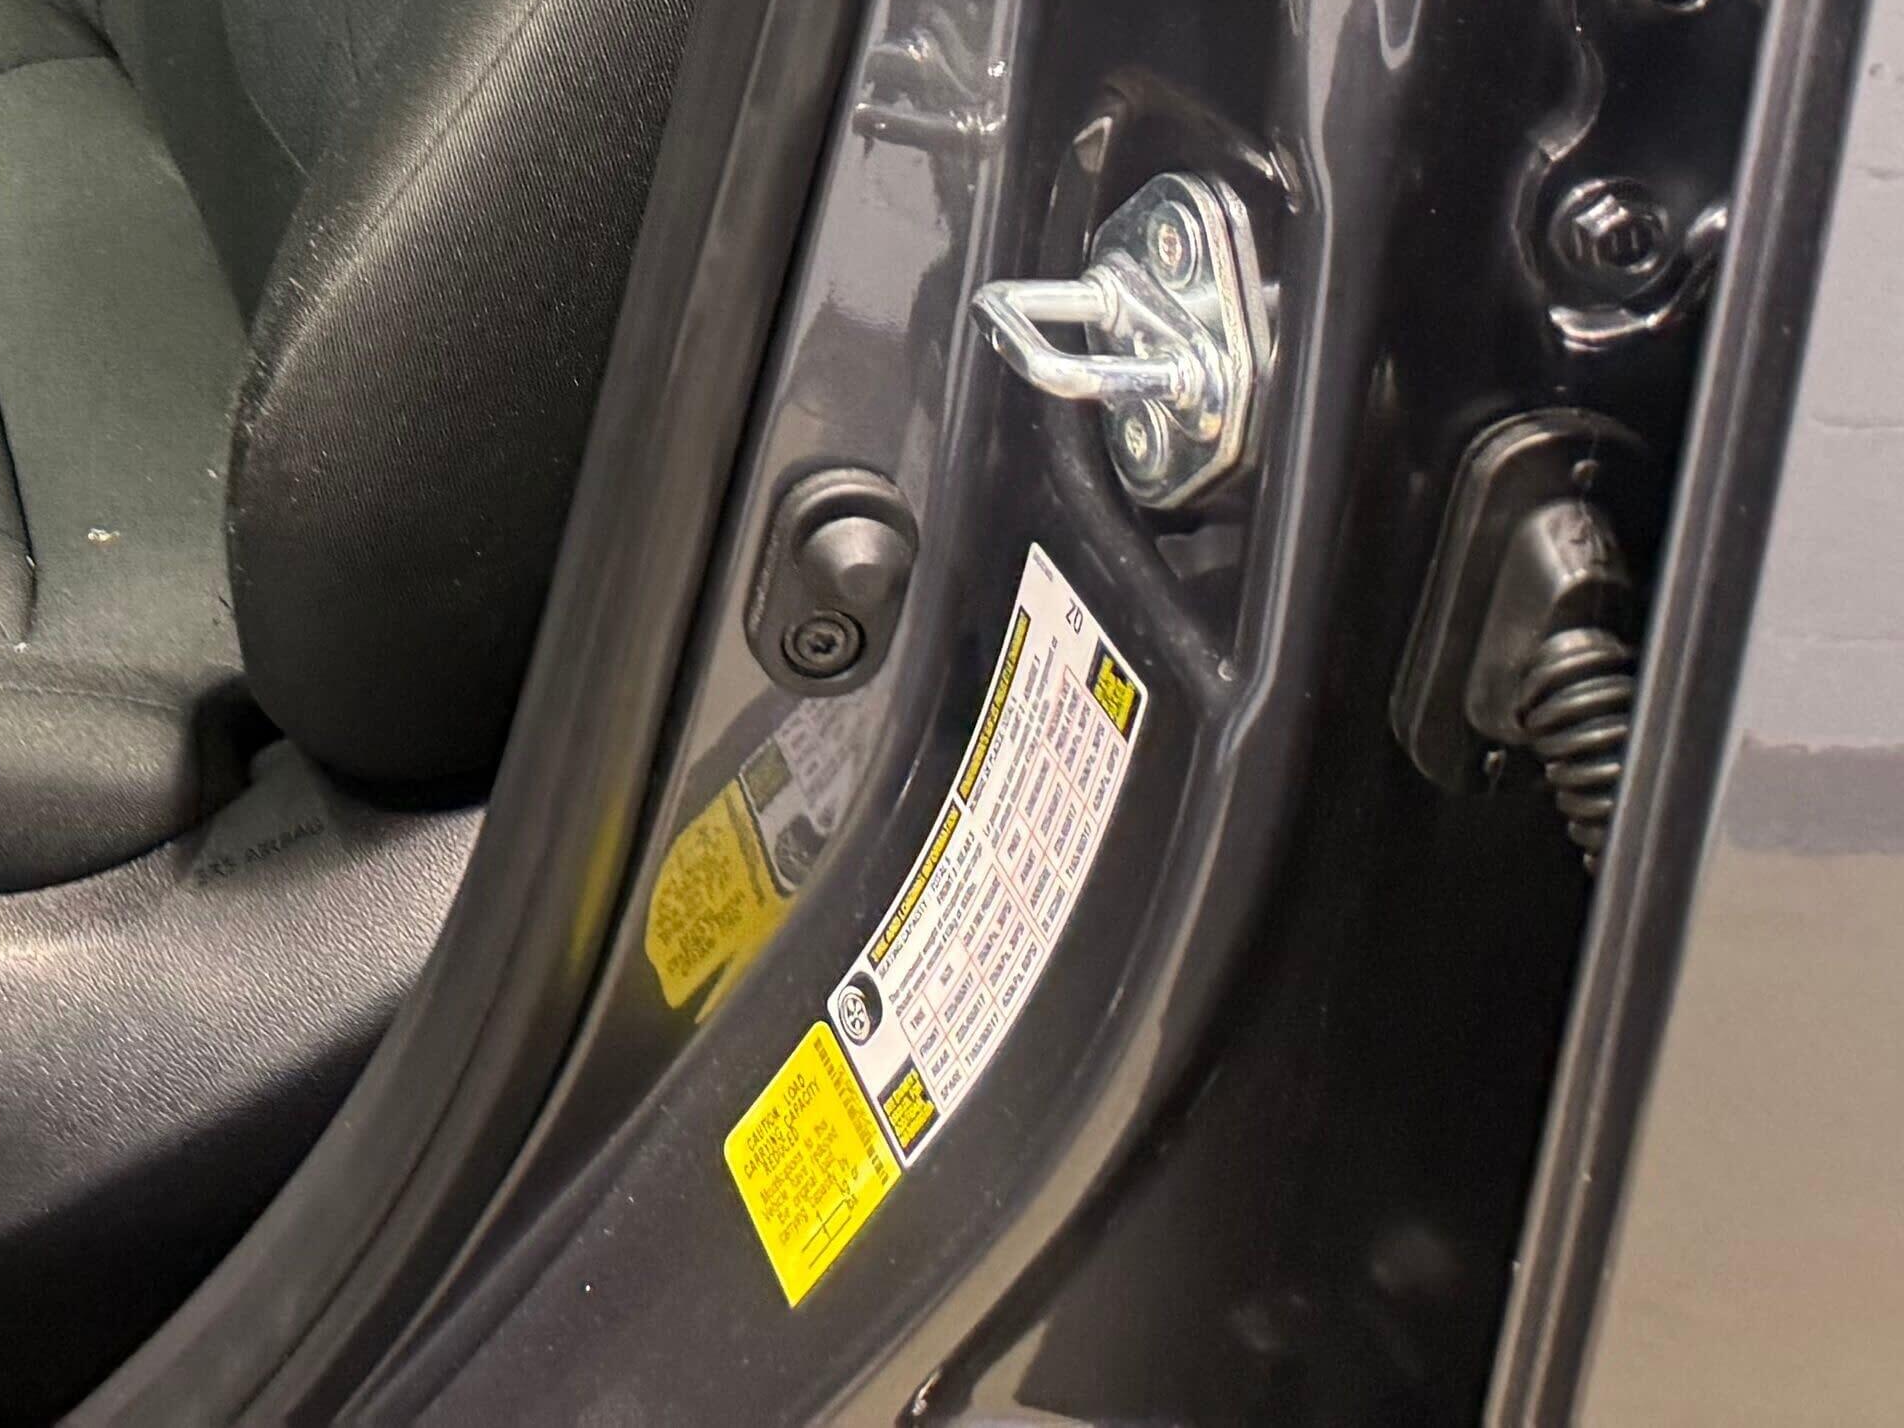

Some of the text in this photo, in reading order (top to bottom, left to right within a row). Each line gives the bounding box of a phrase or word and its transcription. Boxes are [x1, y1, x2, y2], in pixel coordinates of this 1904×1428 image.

[745, 1070, 806, 1153] CAUTION LOAD
[782, 1076, 821, 1130] CAPACITY
[761, 1122, 800, 1177] REDUCED
